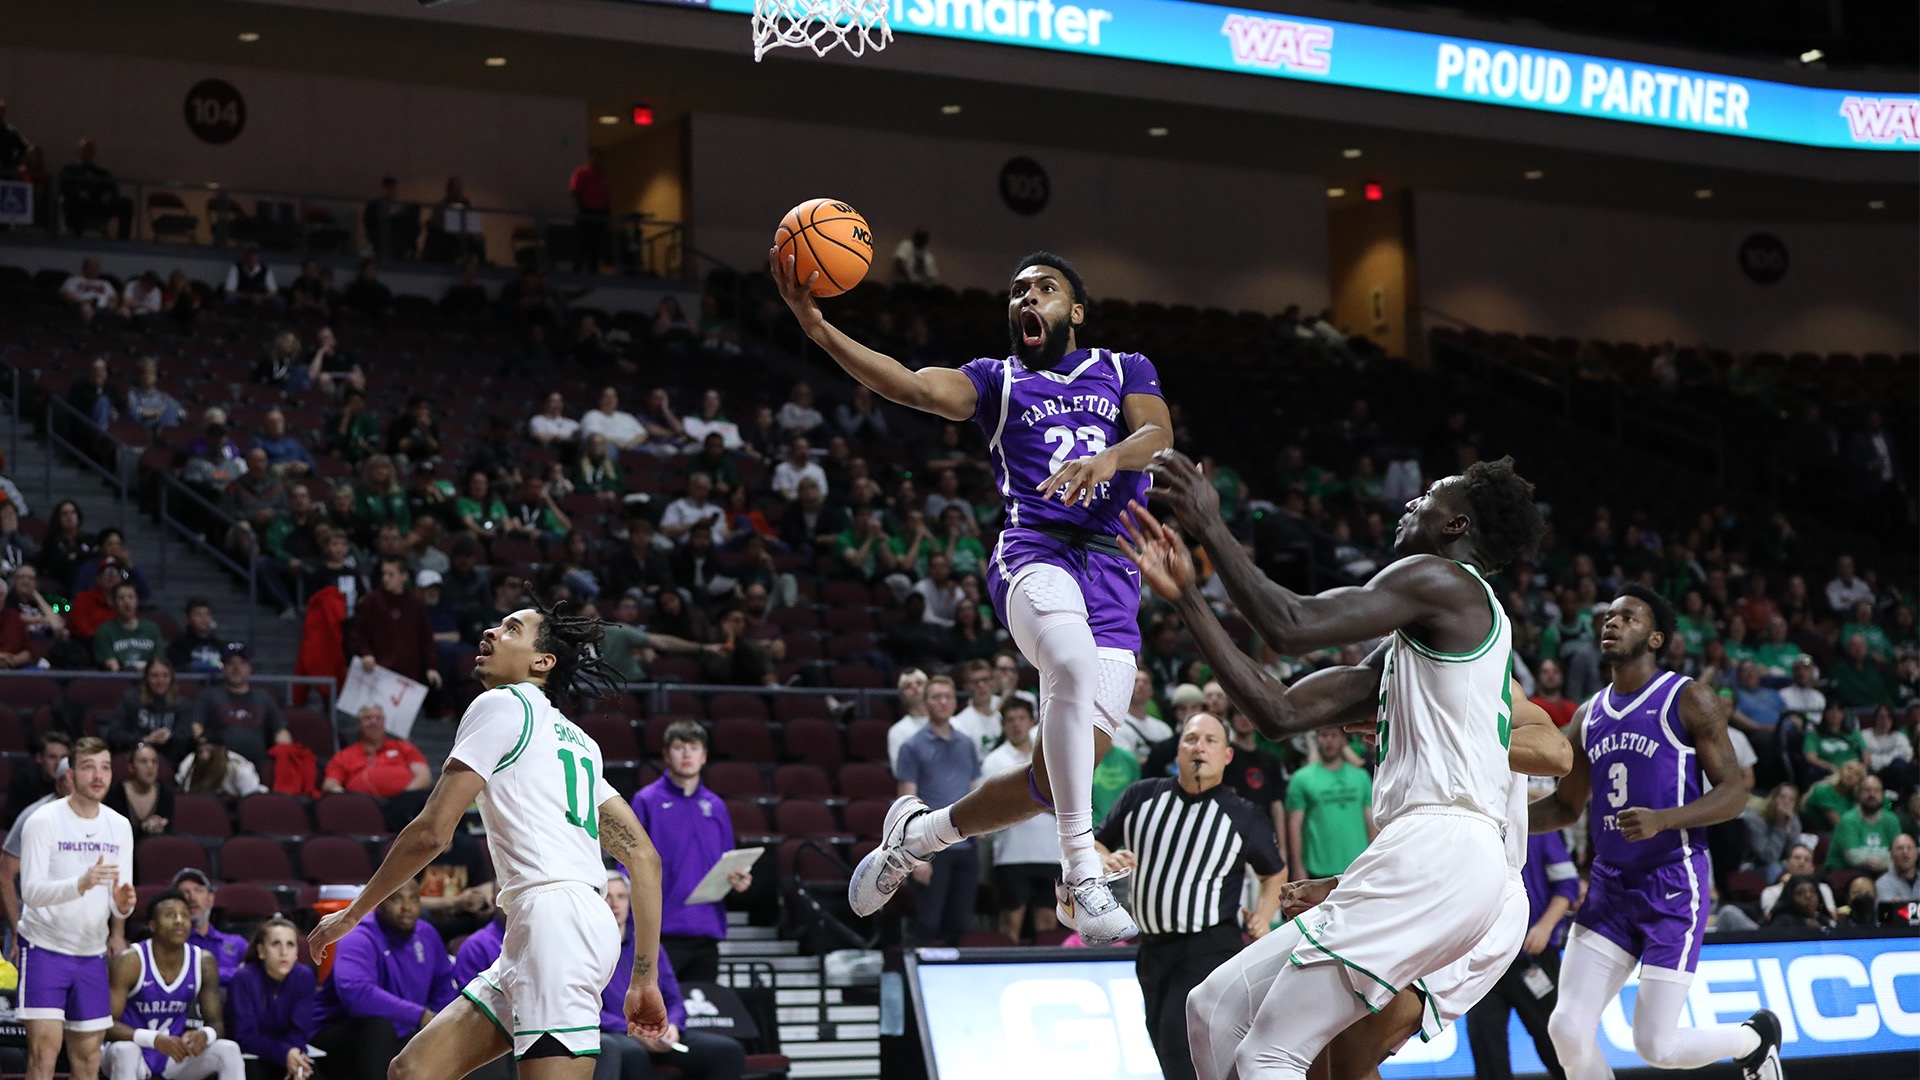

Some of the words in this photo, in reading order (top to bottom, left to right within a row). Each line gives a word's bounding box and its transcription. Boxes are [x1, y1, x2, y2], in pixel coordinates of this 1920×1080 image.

[1221, 14, 1334, 75] WAC
[1436, 42, 1572, 105] PROUD
[1580, 62, 1750, 129] PARTNER
[191, 97, 240, 127] 104
[1007, 172, 1045, 201] 105
[1021, 394, 1121, 427] TARLETON
[1045, 425, 1107, 476] 23
[554, 723, 590, 753] SMALL
[1588, 732, 1660, 764] TARLETON
[557, 748, 598, 840] 11
[1607, 762, 1629, 808] 3
[58, 842, 100, 852] TARLETON
